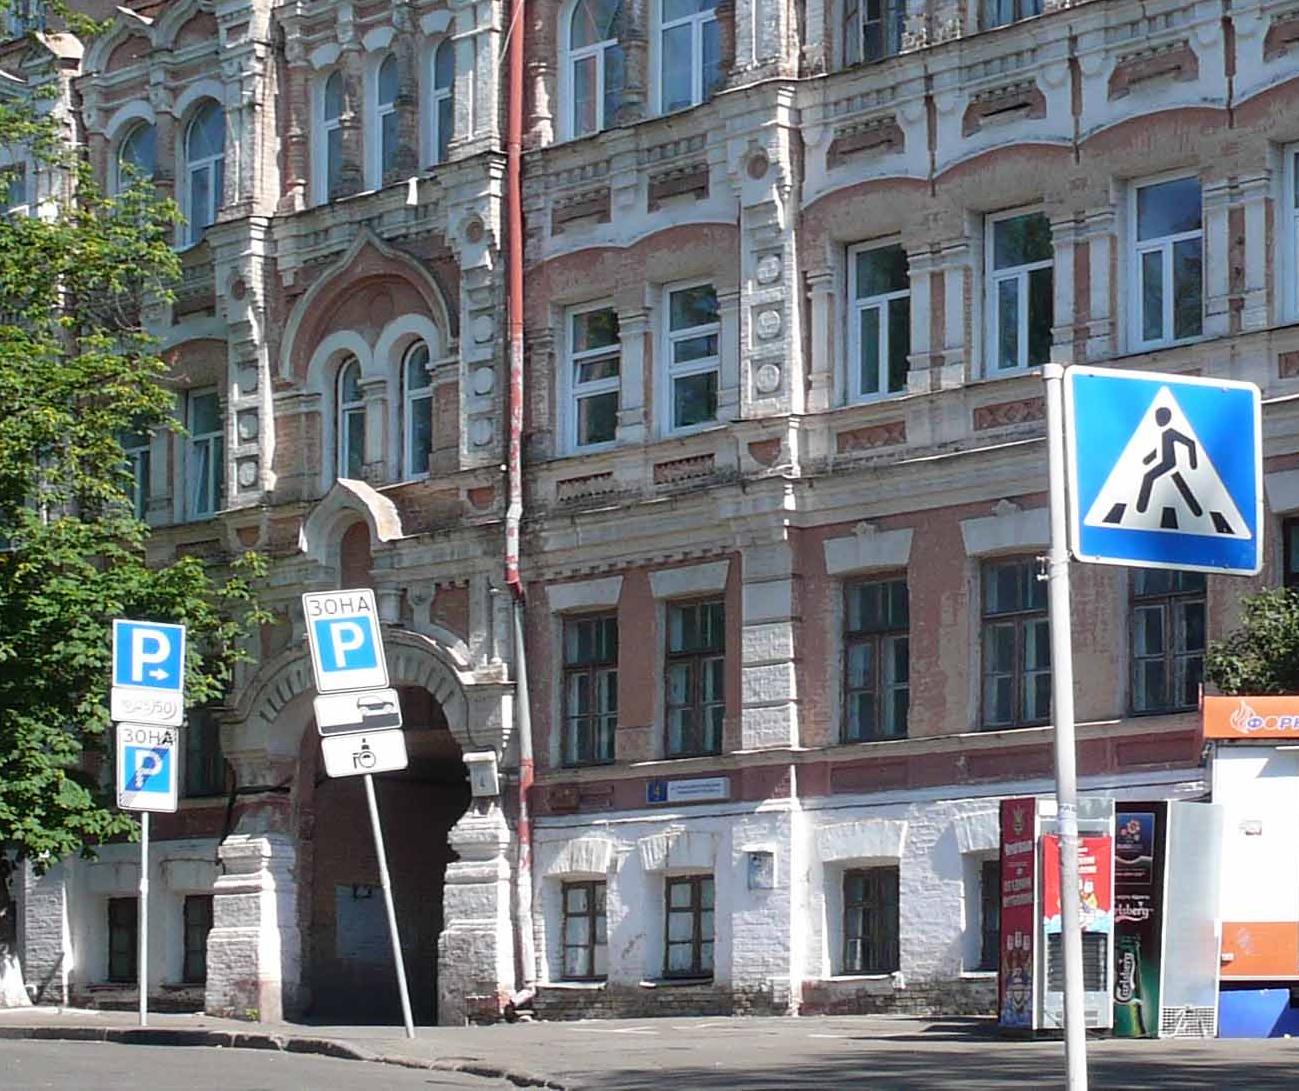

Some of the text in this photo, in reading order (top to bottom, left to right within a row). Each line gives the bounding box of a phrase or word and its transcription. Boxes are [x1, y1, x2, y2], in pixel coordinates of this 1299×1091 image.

[309, 595, 371, 616] ЗОНА
[131, 628, 171, 682] P
[329, 621, 365, 669] P
[123, 728, 174, 745] ЗОНА
[134, 749, 163, 789] P
